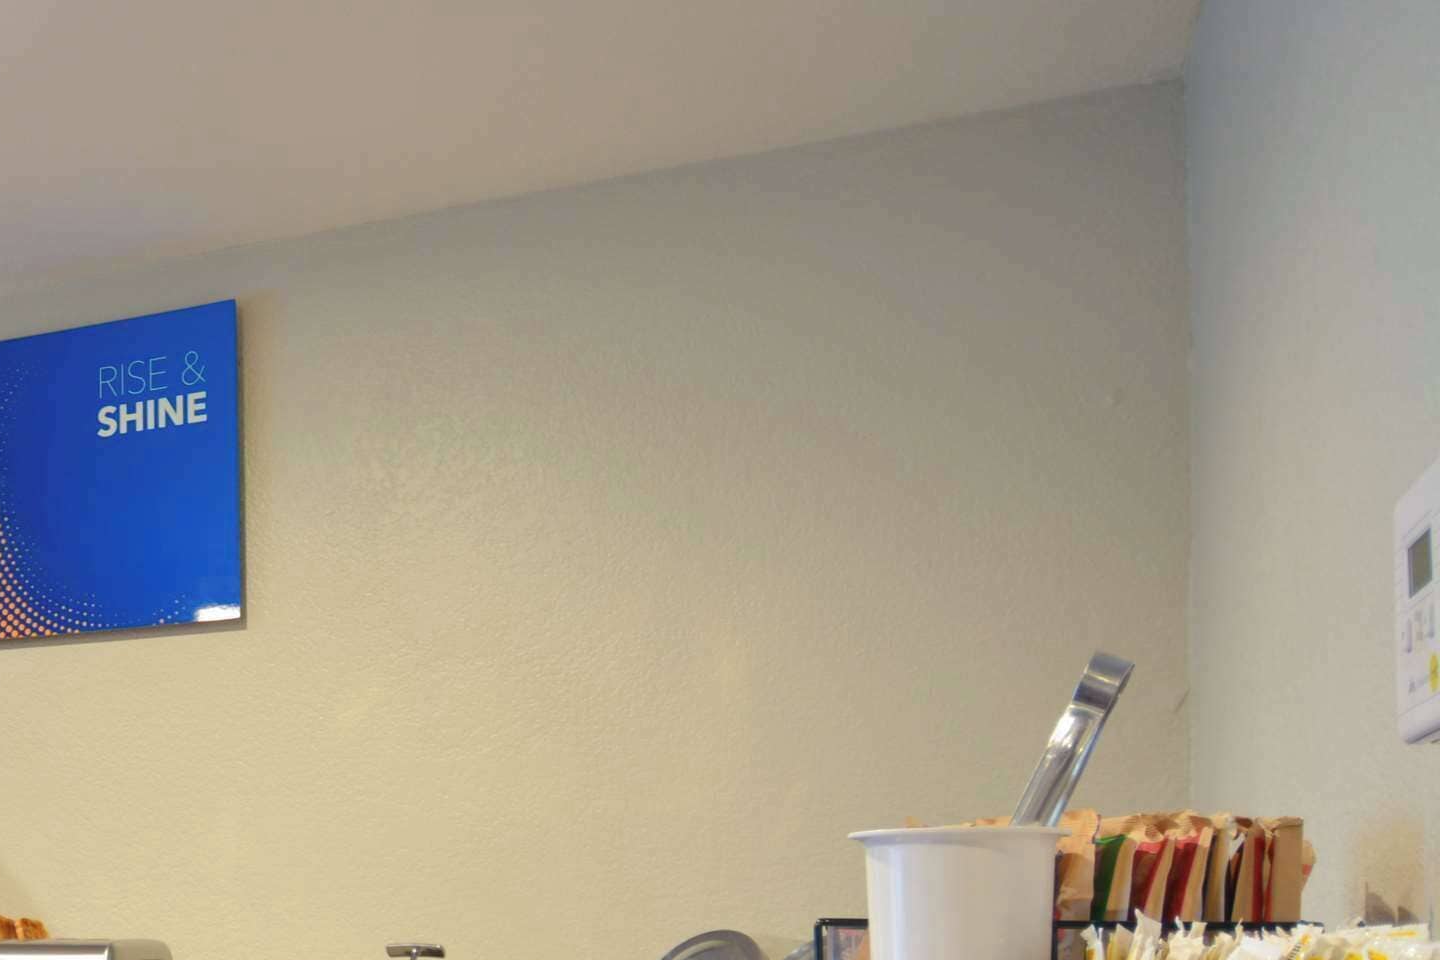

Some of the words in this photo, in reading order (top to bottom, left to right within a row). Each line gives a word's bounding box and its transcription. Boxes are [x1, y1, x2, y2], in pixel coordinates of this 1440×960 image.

[99, 356, 168, 400] RISE
[182, 350, 206, 386] &
[97, 391, 208, 438] SHINE
